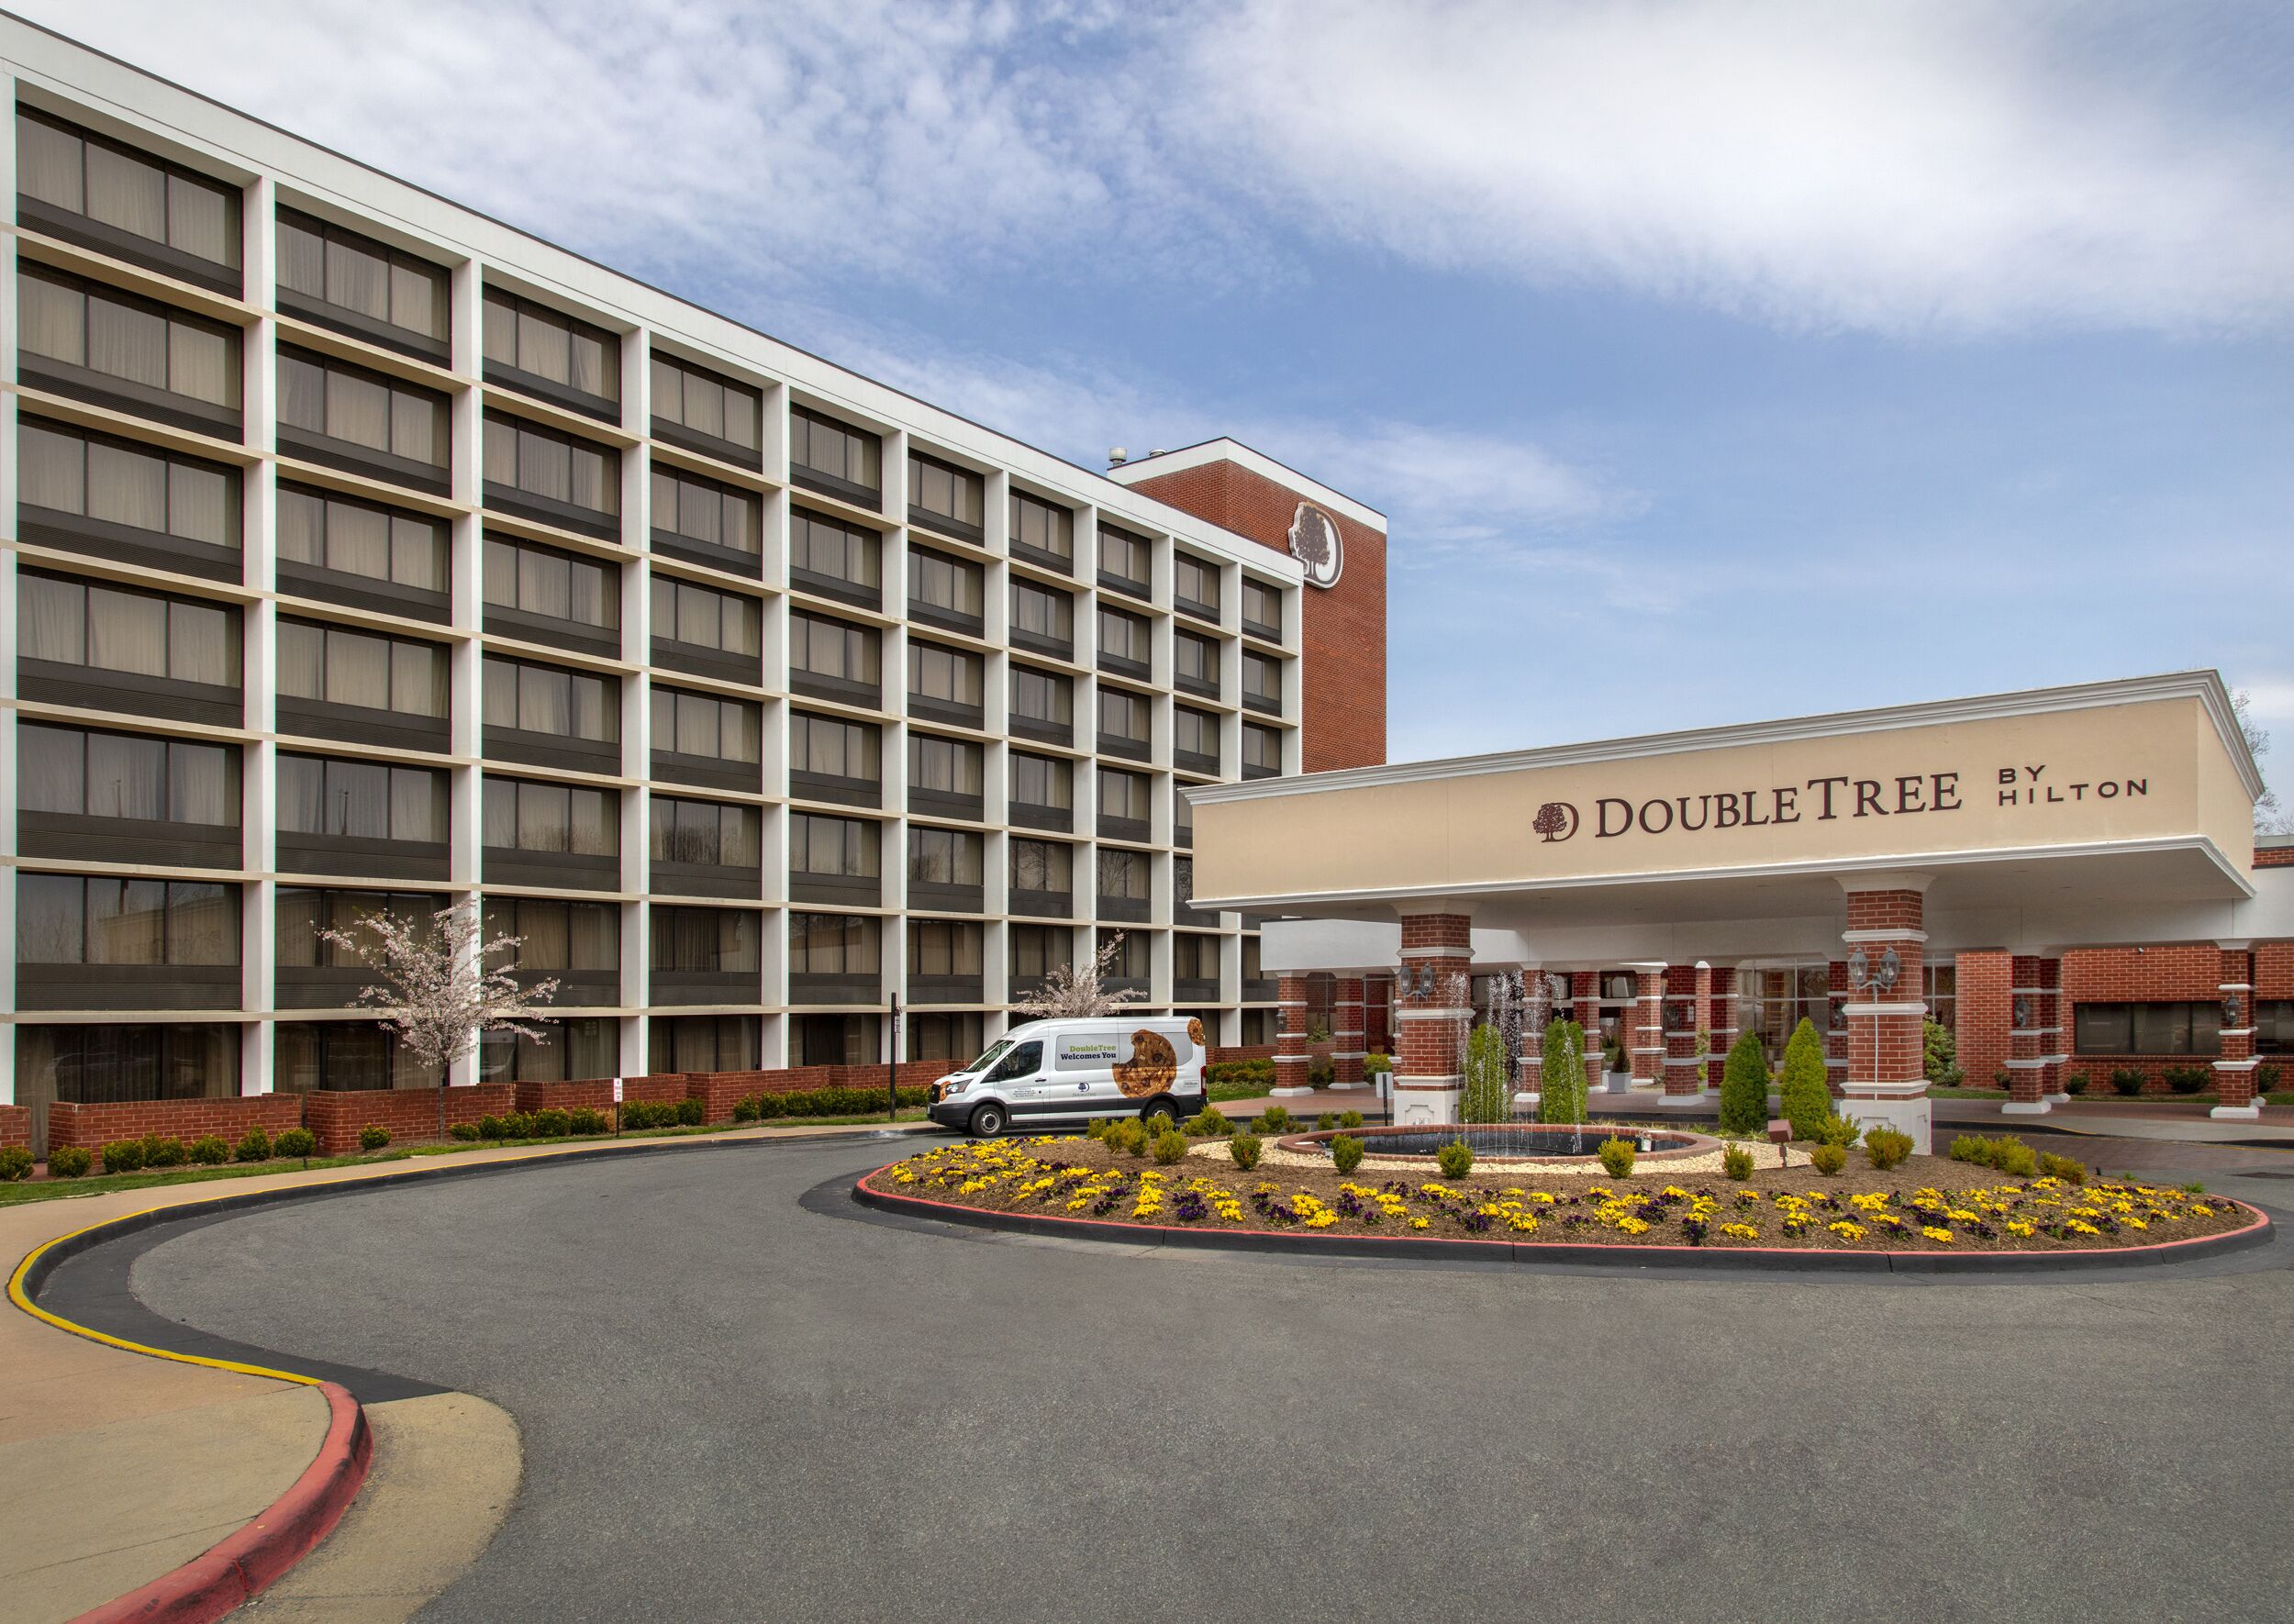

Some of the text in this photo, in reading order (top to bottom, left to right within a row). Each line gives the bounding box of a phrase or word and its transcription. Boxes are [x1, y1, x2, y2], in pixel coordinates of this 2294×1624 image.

[1999, 764, 2046, 785] BY
[1999, 778, 2148, 807] HILTON
[1069, 1044, 1117, 1052] DoubleTree
